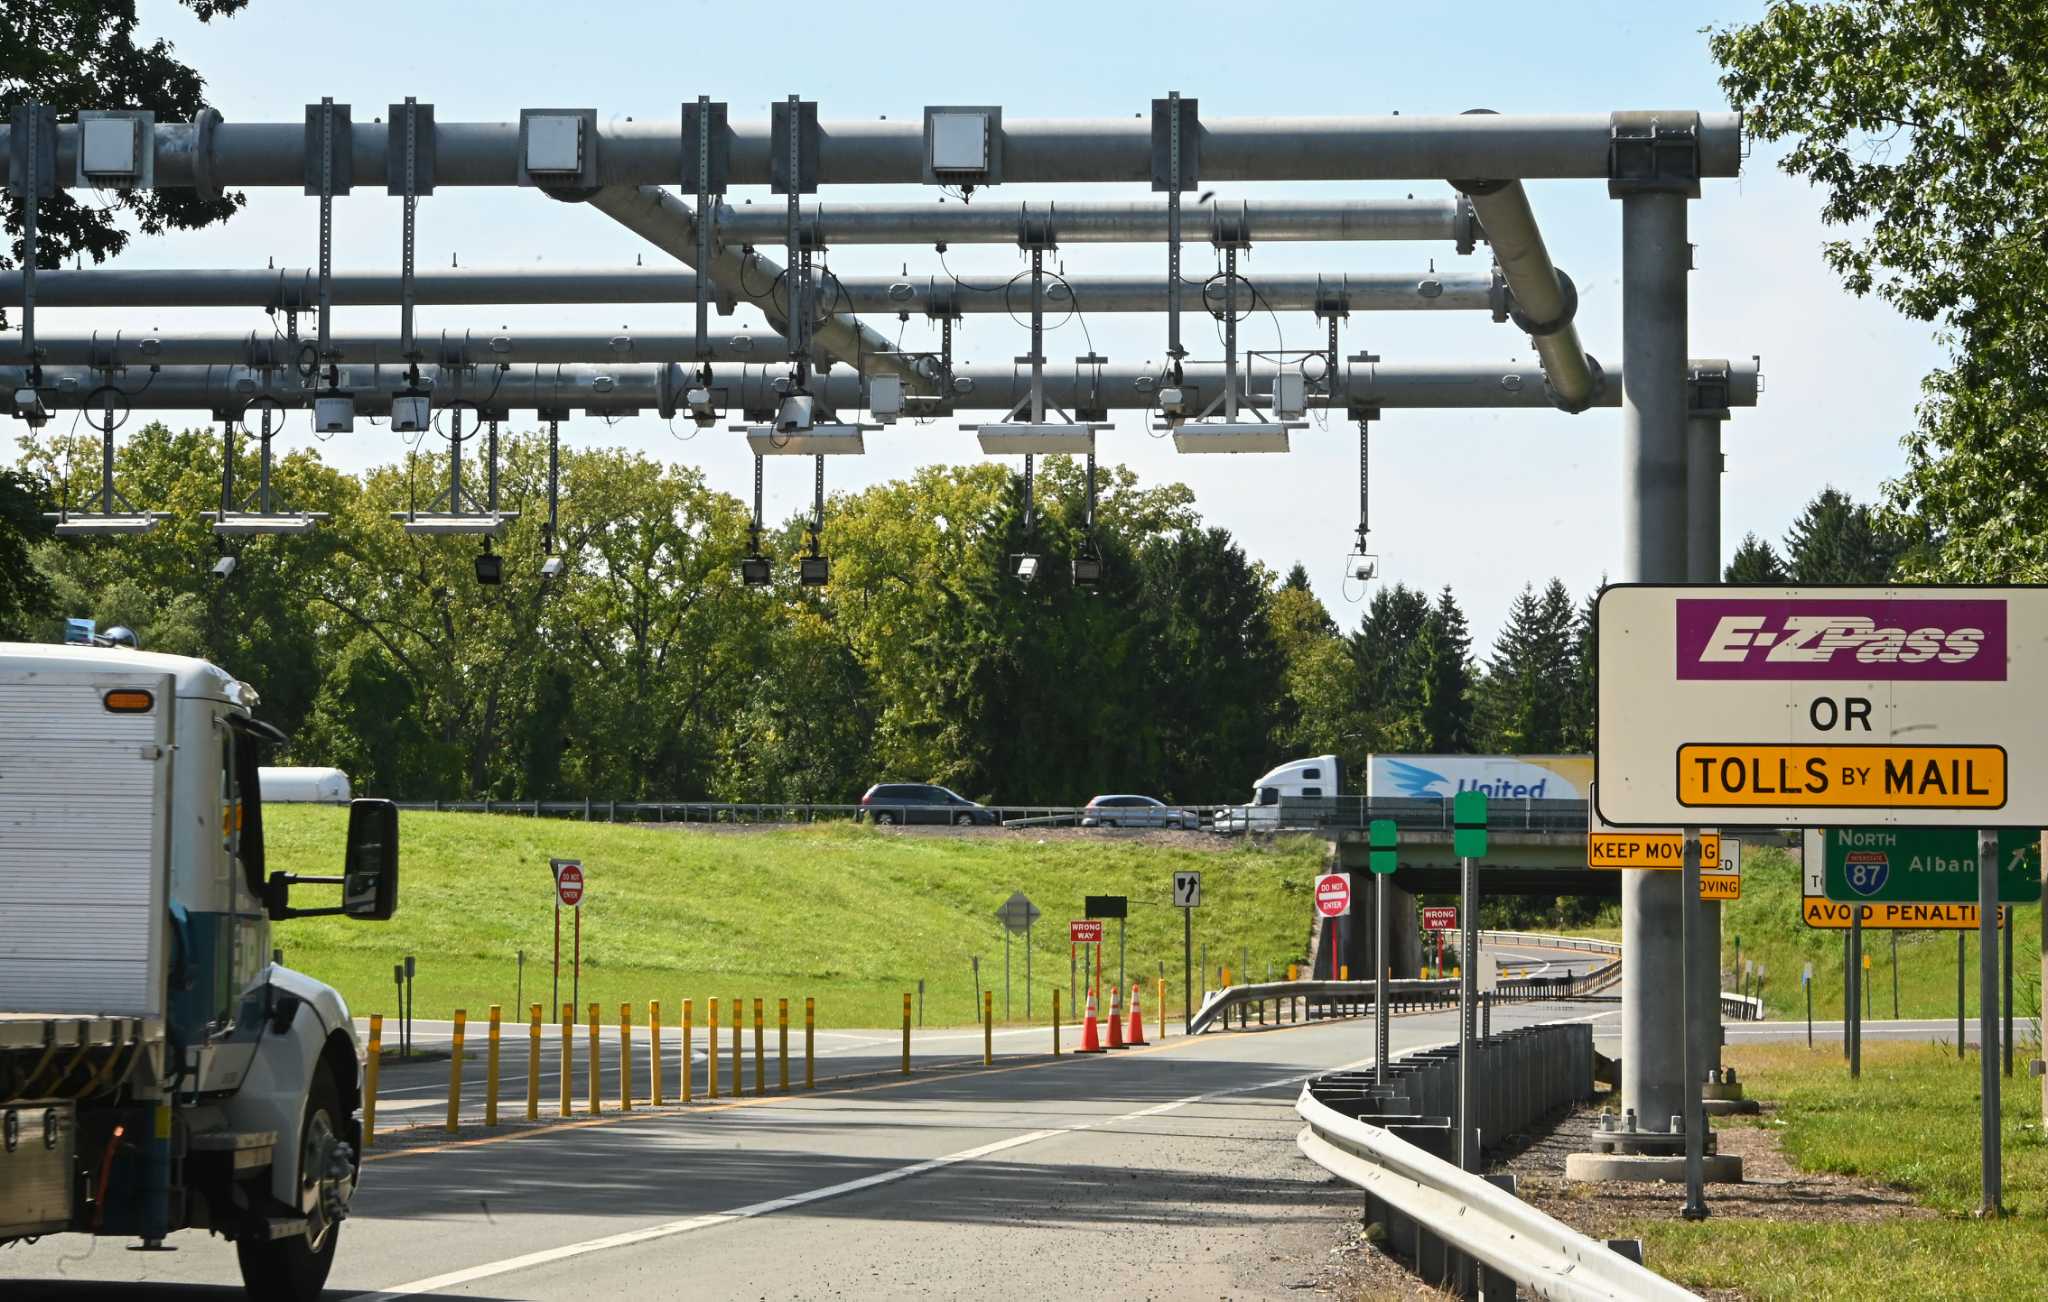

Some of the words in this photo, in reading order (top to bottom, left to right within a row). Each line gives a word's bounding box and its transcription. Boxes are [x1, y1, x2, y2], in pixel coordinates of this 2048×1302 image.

[1698, 616, 1985, 663] E-ZPass
[1809, 696, 1872, 731] OR
[1694, 757, 1829, 794] TOLLS
[1842, 767, 1871, 786] BY
[1885, 759, 1989, 795] MAIL
[1458, 778, 1547, 798] United
[1838, 829, 1896, 846] NORTH
[1593, 842, 1640, 859] KEEP
[1646, 843, 1716, 859] MOVG
[1908, 855, 1975, 873] Alban
[1853, 865, 1880, 886] 87
[1321, 884, 1329, 892] DO
[1331, 882, 1344, 891] NOT
[1700, 881, 1737, 892] OVING
[1323, 901, 1342, 910] ENTER
[1808, 904, 1873, 920] AVOD
[1072, 923, 1100, 931] WRONG
